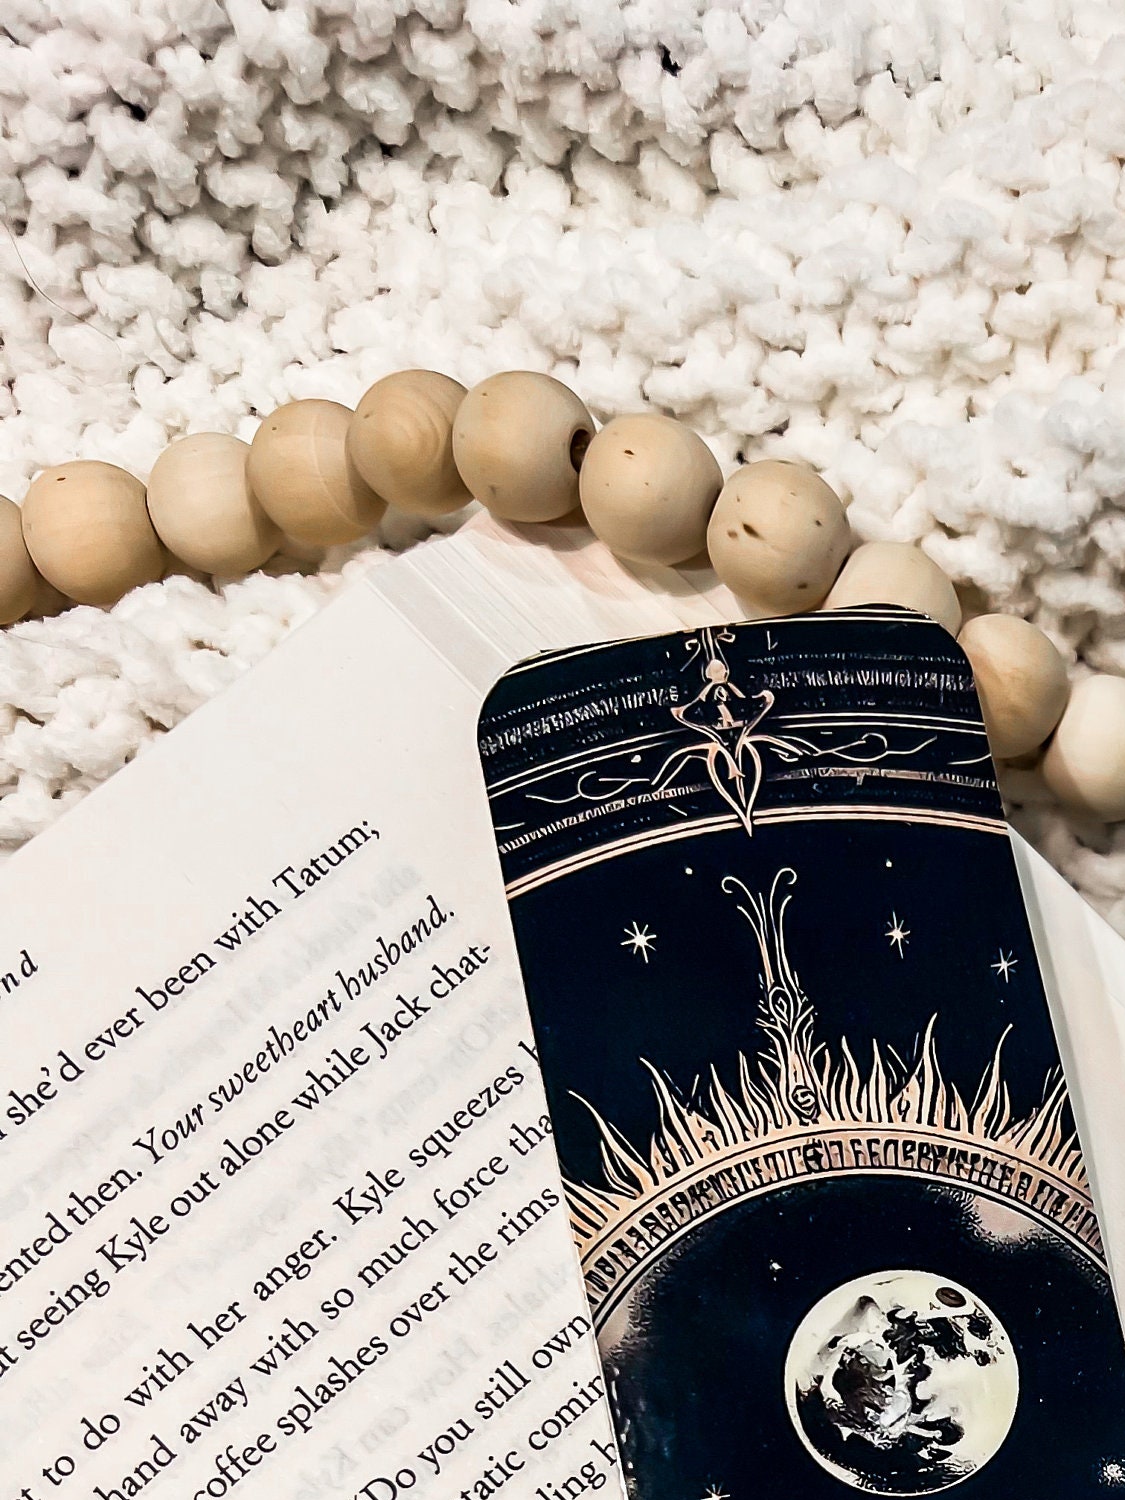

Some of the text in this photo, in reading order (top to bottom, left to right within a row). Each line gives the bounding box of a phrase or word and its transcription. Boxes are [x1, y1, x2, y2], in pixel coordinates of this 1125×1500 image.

[66, 894, 455, 1226] then. Your sweetheart husband.
[84, 1007, 145, 1061] ever
[134, 952, 218, 1012] been
[213, 895, 283, 951] with
[271, 820, 380, 899] Tatum;
[16, 945, 491, 1351] seeing Kyle out alone while Jack chat-
[123, 1066, 525, 1407] with anger. Kyle squeezes
[180, 1376, 248, 1444] away
[249, 1317, 320, 1376] with
[320, 1288, 355, 1320] so
[357, 1215, 439, 1289] much
[433, 1156, 509, 1220] force
[276, 1335, 389, 1437] splashes
[389, 1281, 451, 1337] over
[448, 1242, 498, 1286] the
[497, 1186, 561, 1248] rims
[474, 1359, 532, 1420] still
[531, 1312, 593, 1370] own
